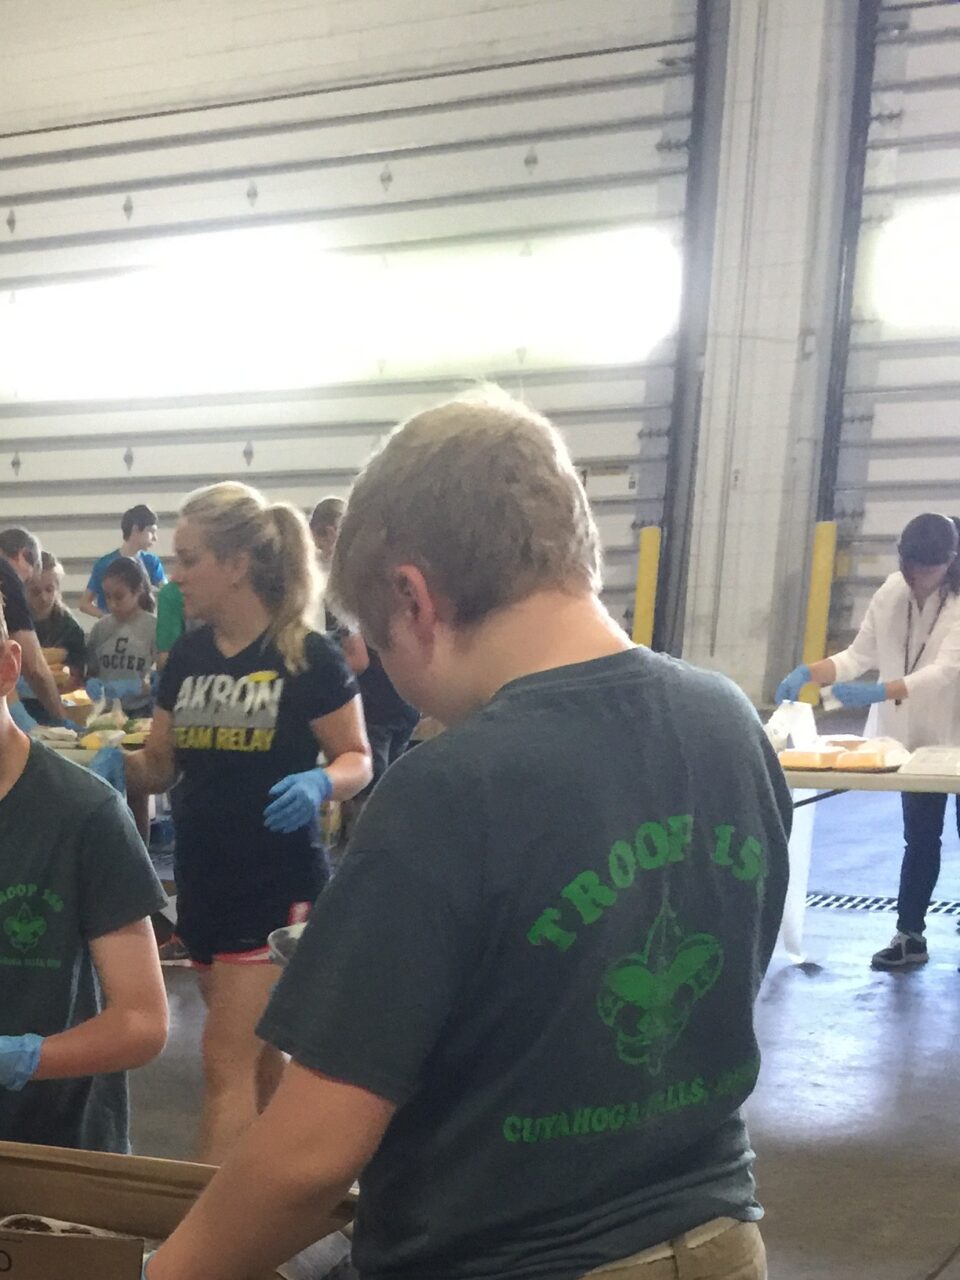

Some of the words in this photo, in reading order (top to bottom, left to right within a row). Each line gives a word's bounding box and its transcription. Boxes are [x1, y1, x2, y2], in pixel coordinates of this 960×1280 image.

[115, 637, 129, 654] C
[173, 673, 284, 718] AKRON
[527, 814, 694, 951] TROOP
